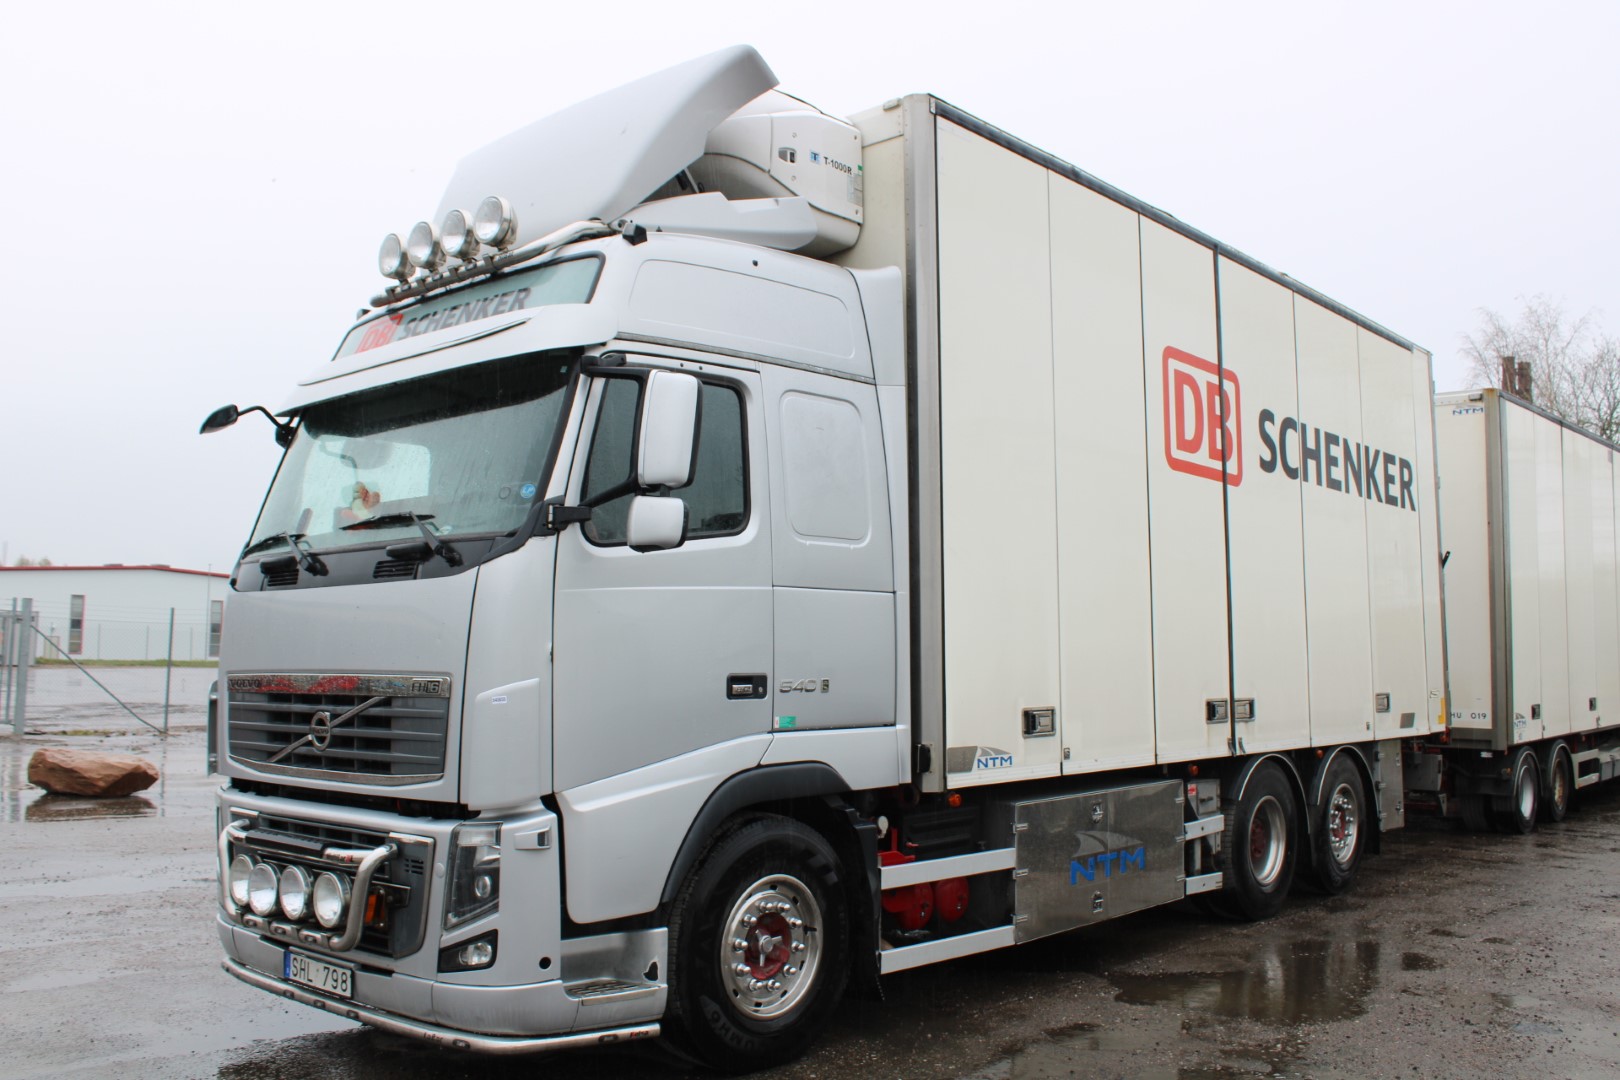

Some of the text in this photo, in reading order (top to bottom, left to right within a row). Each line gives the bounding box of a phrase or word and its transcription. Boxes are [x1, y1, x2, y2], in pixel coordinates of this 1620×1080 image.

[823, 156, 853, 176] T-1000R
[400, 288, 531, 340] SCHENKER
[1452, 407, 1484, 417] NTM
[1172, 366, 1417, 512] DB SCHENKER
[229, 679, 261, 690] VOLVO
[411, 680, 441, 693] FH16
[779, 679, 817, 694] 540
[1470, 711, 1487, 720] 019
[977, 755, 1013, 769] NTM
[1069, 847, 1146, 886] NTM
[291, 957, 348, 992] SHL 798
